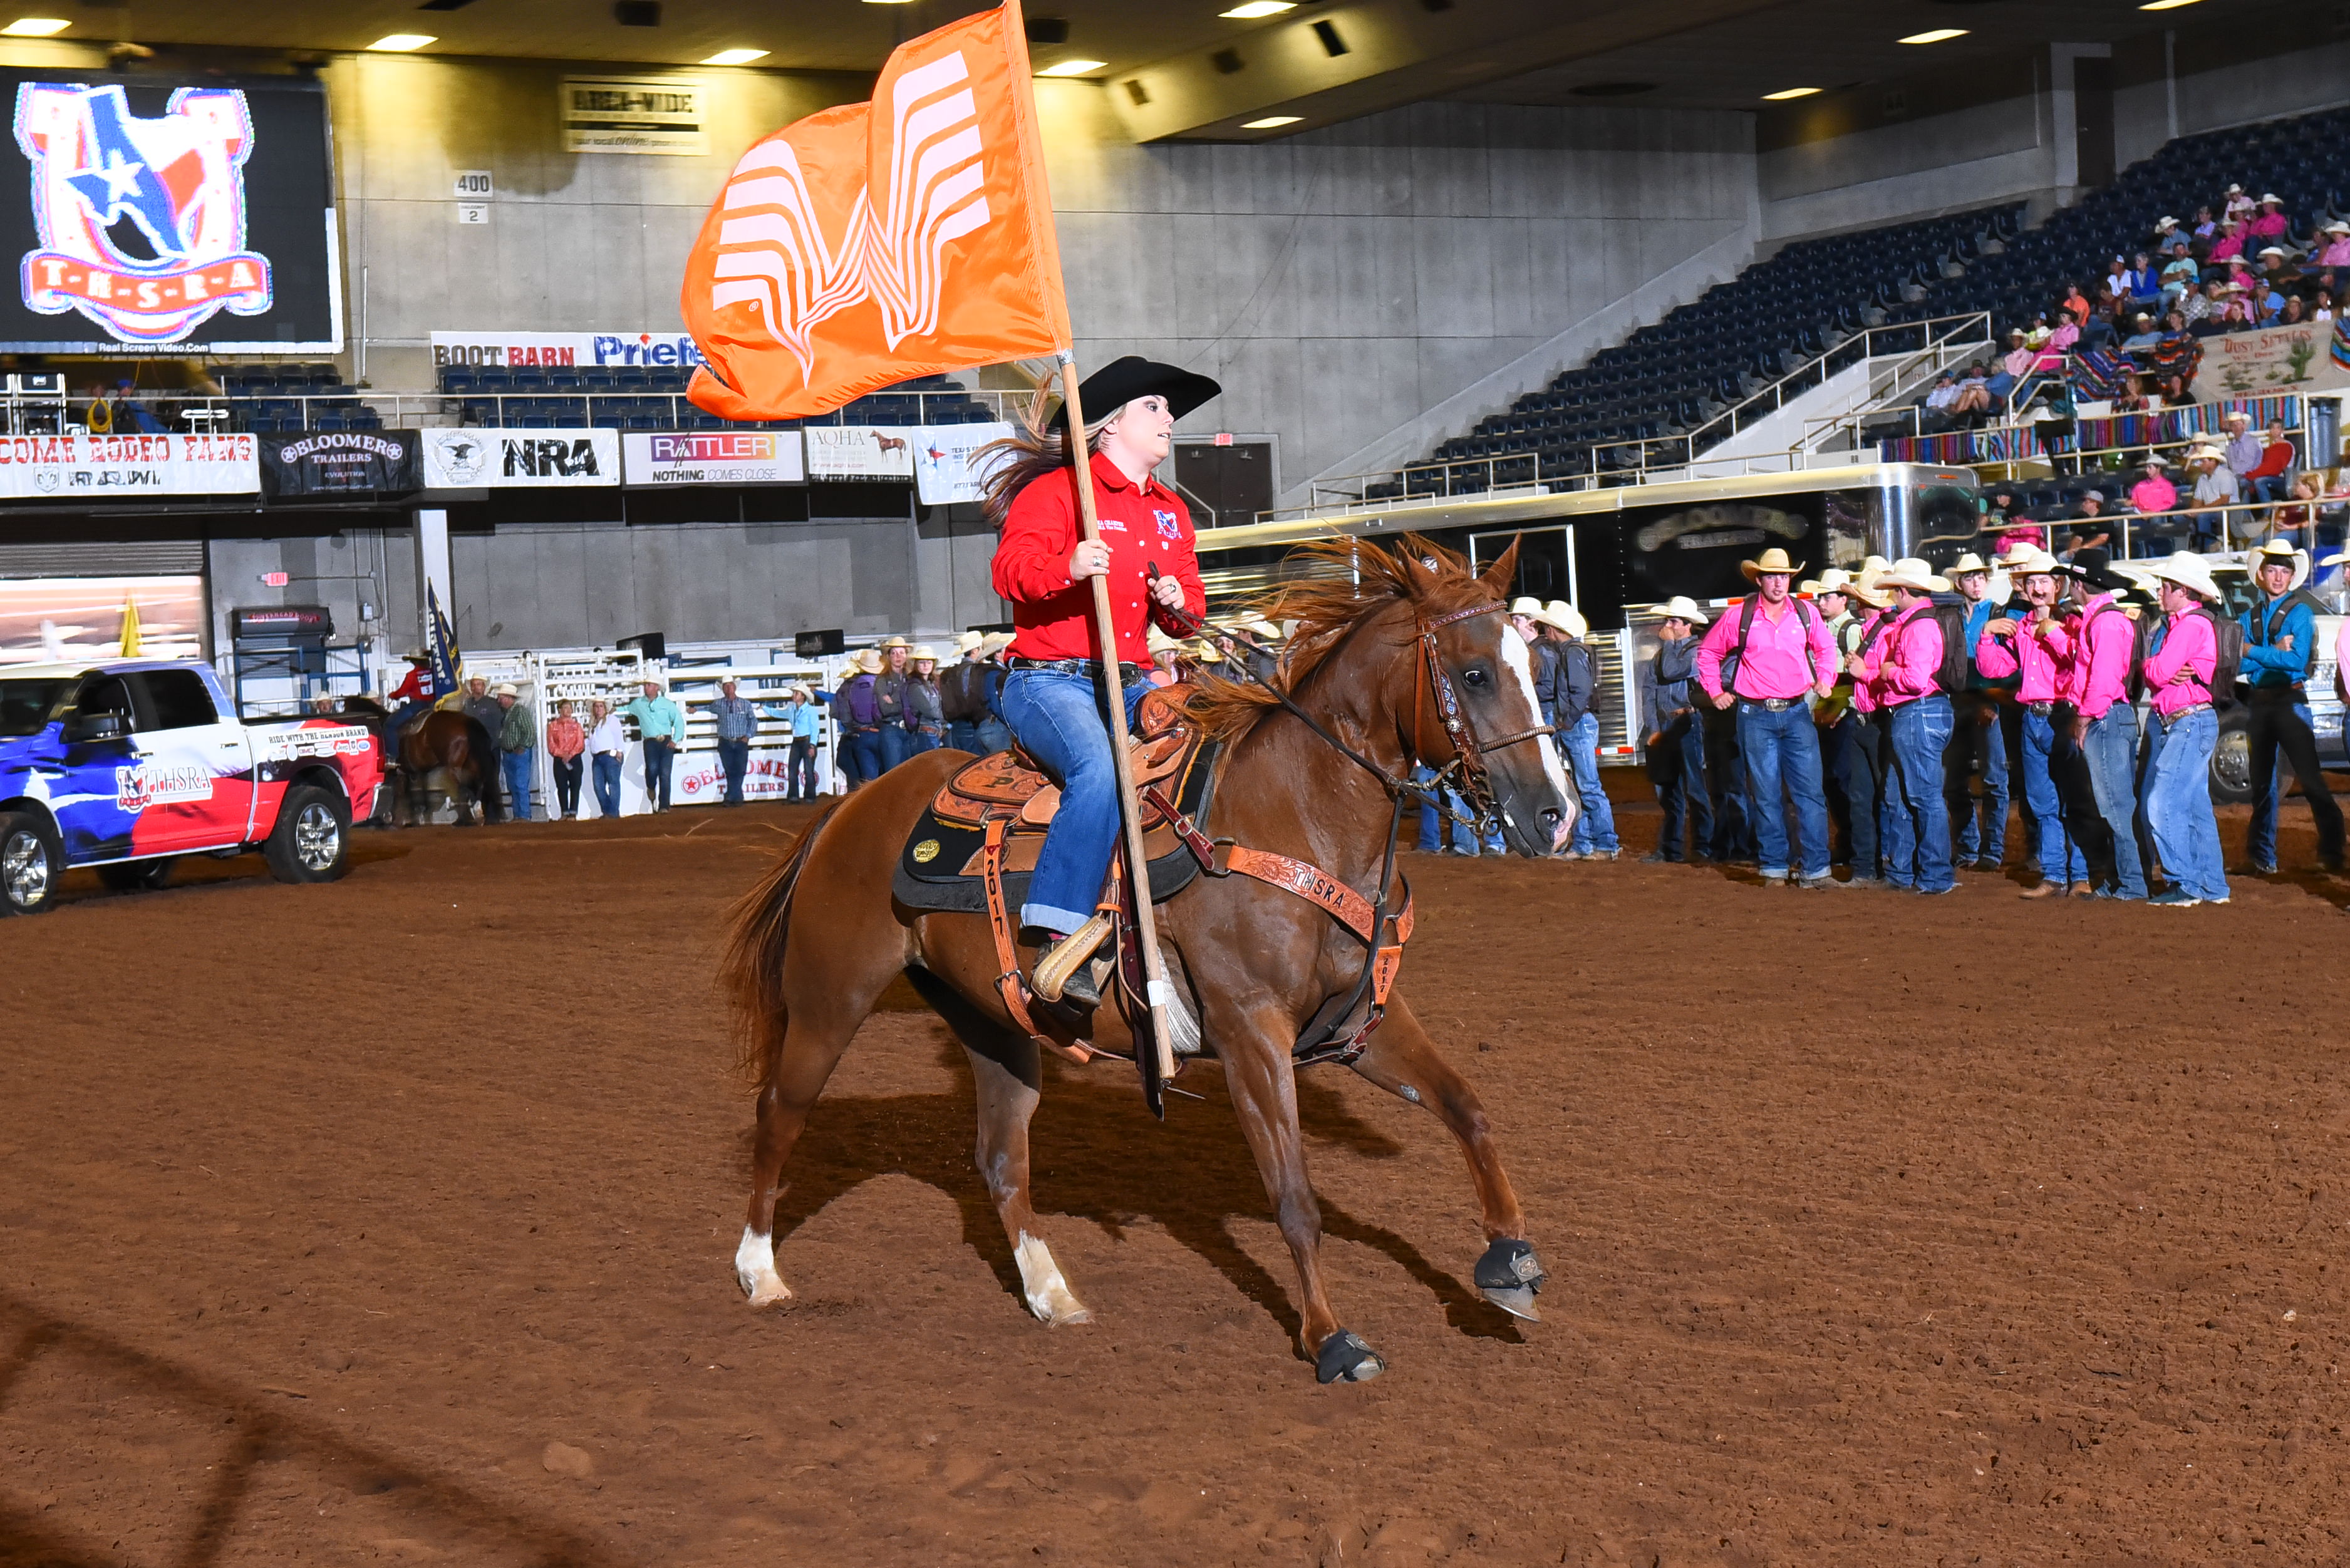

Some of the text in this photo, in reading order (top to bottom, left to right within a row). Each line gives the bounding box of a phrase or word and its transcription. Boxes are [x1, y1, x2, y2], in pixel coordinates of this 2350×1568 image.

[458, 175, 490, 193] 400
[469, 210, 479, 222] 2
[99, 343, 120, 353] Real
[122, 343, 157, 353] Screen
[433, 344, 575, 367] BOOT BARN
[88, 436, 171, 463] RODEO
[294, 433, 388, 458] BLOOMER
[654, 436, 772, 458] RATTLER
[812, 430, 866, 449] AQHA
[311, 453, 373, 464] TRAILERS
[502, 438, 601, 477] NRA
[653, 468, 777, 482] NOTHING COMES CLOSE
[269, 735, 286, 744] RIDE
[286, 733, 304, 743] WITH
[305, 731, 319, 740] THE
[150, 766, 211, 793] THSRA
[717, 782, 784, 794] TILERS
[986, 859, 1004, 936] 2017
[1294, 867, 1345, 909] THSRA
[1379, 957, 1390, 994] 2017
